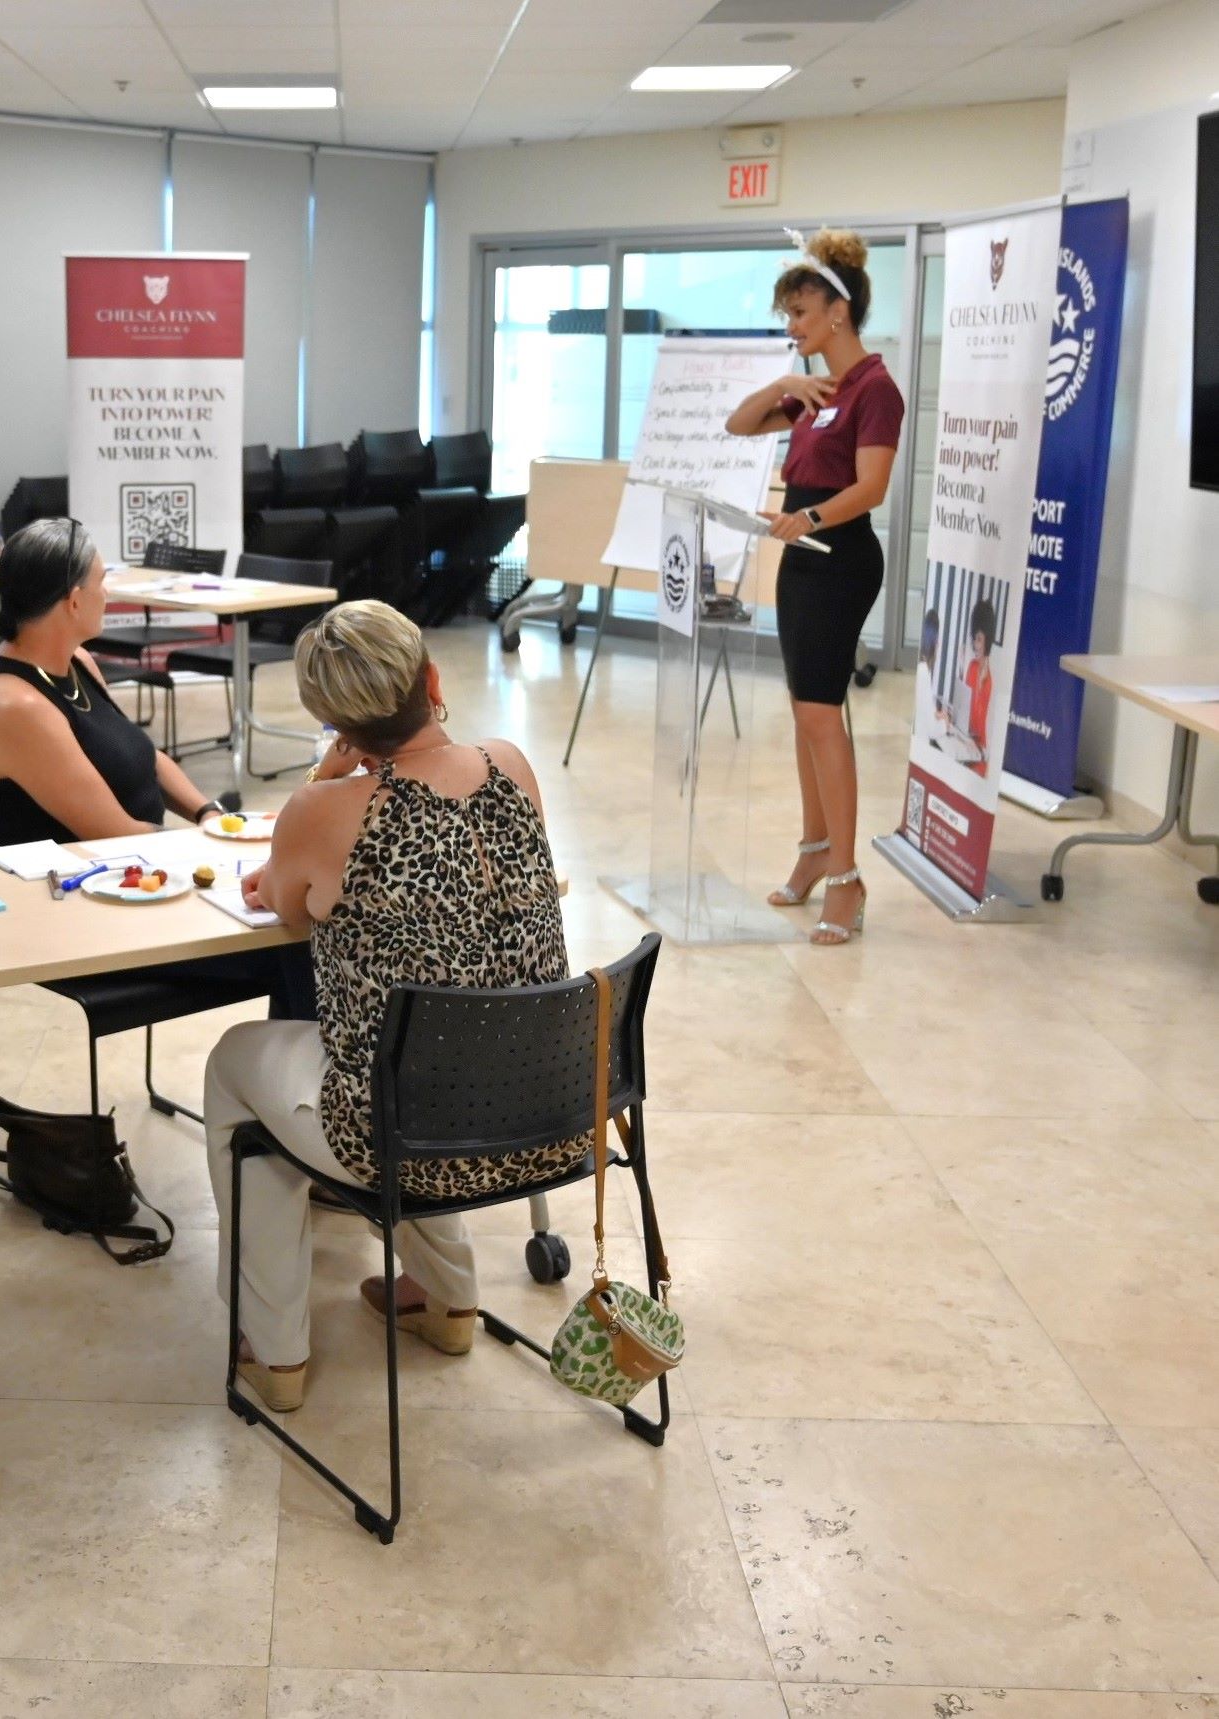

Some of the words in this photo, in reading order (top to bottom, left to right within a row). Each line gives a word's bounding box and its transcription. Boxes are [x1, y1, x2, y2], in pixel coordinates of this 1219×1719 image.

[729, 163, 768, 199] EXIT
[96, 309, 166, 322] CHELSEA
[169, 309, 217, 322] FLYNN
[949, 304, 998, 328] CHELSEA
[1001, 301, 1037, 325] FLYNN
[1048, 327, 1096, 421] COMMERCE
[88, 387, 132, 401] TURN
[136, 387, 185, 401] YOUR
[188, 387, 225, 401] PAIN
[101, 407, 142, 421] INTO
[146, 407, 212, 421] POWER!
[943, 411, 967, 435] Turn
[969, 417, 991, 442] your
[992, 414, 1018, 445] pain
[113, 427, 183, 441] BECOME
[191, 427, 201, 441] A
[98, 446, 171, 461] MEMBER
[174, 446, 218, 460] NOW.
[939, 441, 961, 466] into
[962, 448, 1000, 474] power!
[937, 473, 977, 502] Become
[978, 485, 985, 504] a
[935, 504, 975, 534] Member
[977, 512, 1002, 540] Now.
[1031, 498, 1066, 525] PORT
[1029, 533, 1065, 561] MOTE
[1026, 567, 1059, 596] TECT
[105, 616, 143, 626] ONTACT
[1009, 710, 1051, 740] hamber.ky
